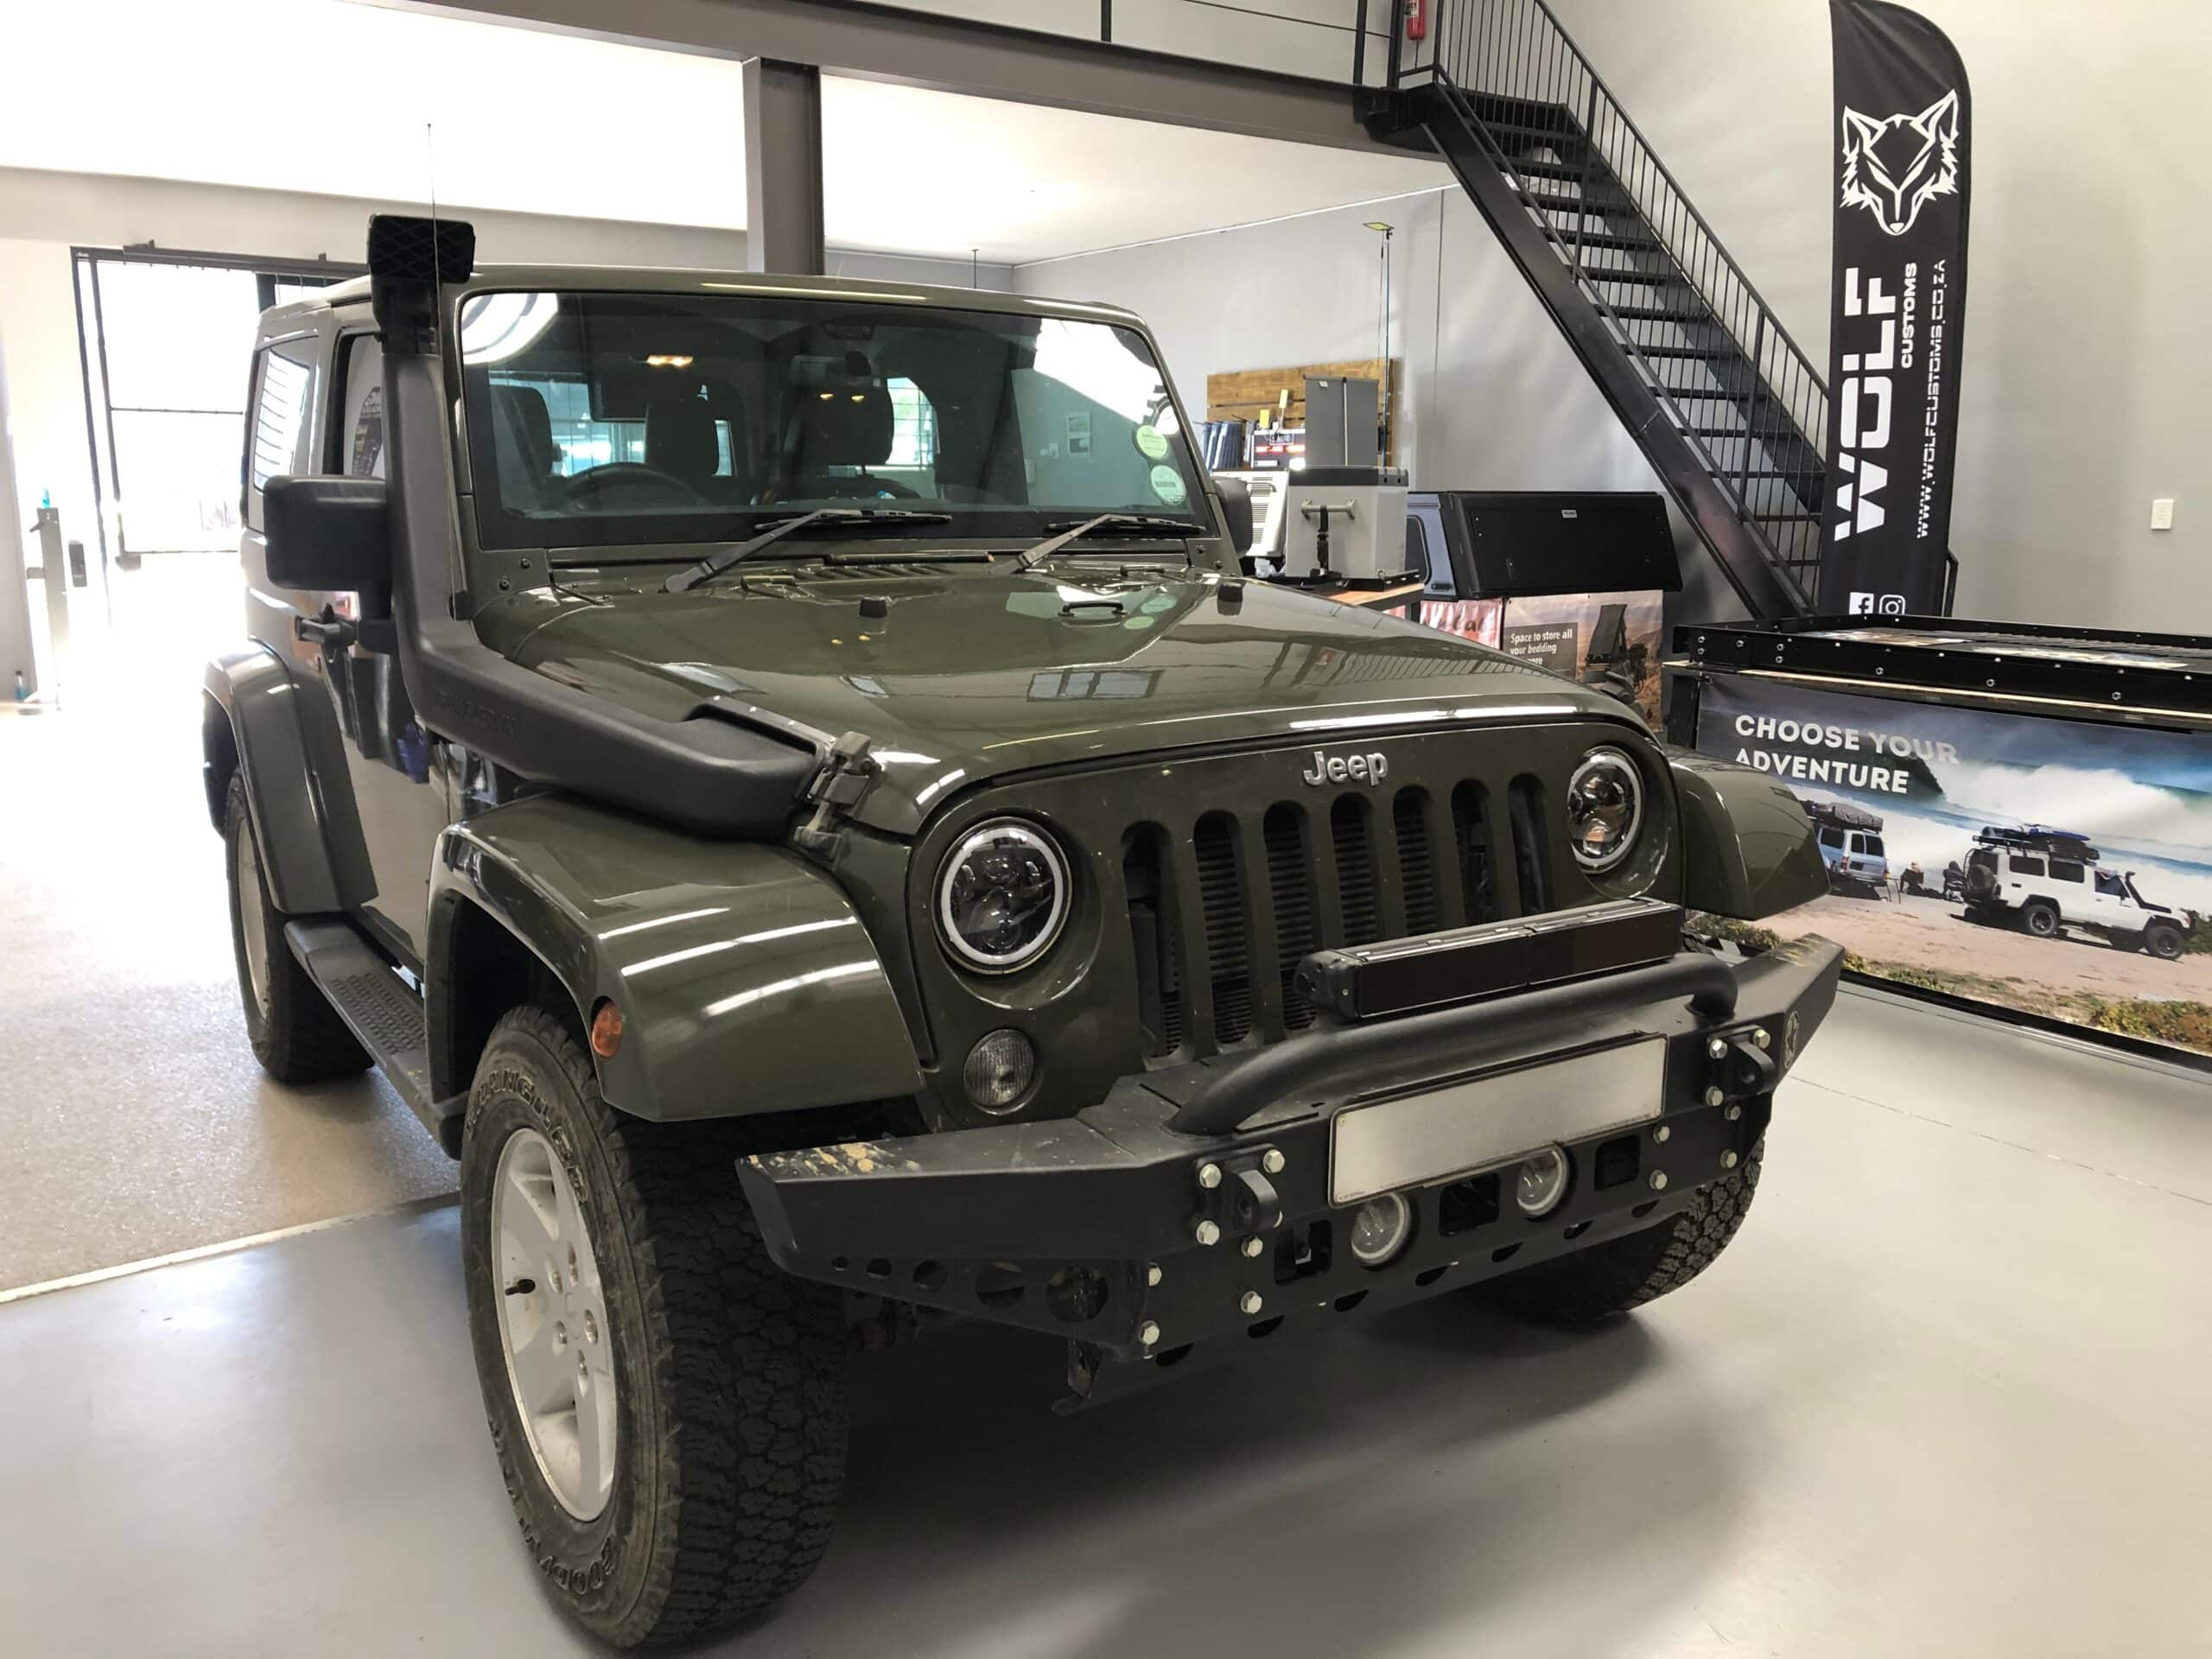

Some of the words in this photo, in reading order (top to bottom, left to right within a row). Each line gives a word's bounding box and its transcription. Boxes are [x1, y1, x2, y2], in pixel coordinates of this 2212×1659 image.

[1901, 262, 1917, 369] CUSTOMS
[1834, 267, 1896, 542] WOLF
[1916, 258, 1947, 540] WWW.WOLFCUSTOMS.CO.ZA
[1510, 633, 1532, 645] Space
[1533, 632, 1541, 642] to
[1542, 631, 1560, 641] store
[1562, 628, 1573, 639] all
[1510, 646, 1527, 656] your
[1528, 642, 1557, 655] bedding
[1735, 715, 1859, 751] CHOOSE
[1869, 732, 1961, 765] YOUR
[1303, 751, 1389, 786] Jeep
[1736, 747, 1910, 794] ADVENTURE
